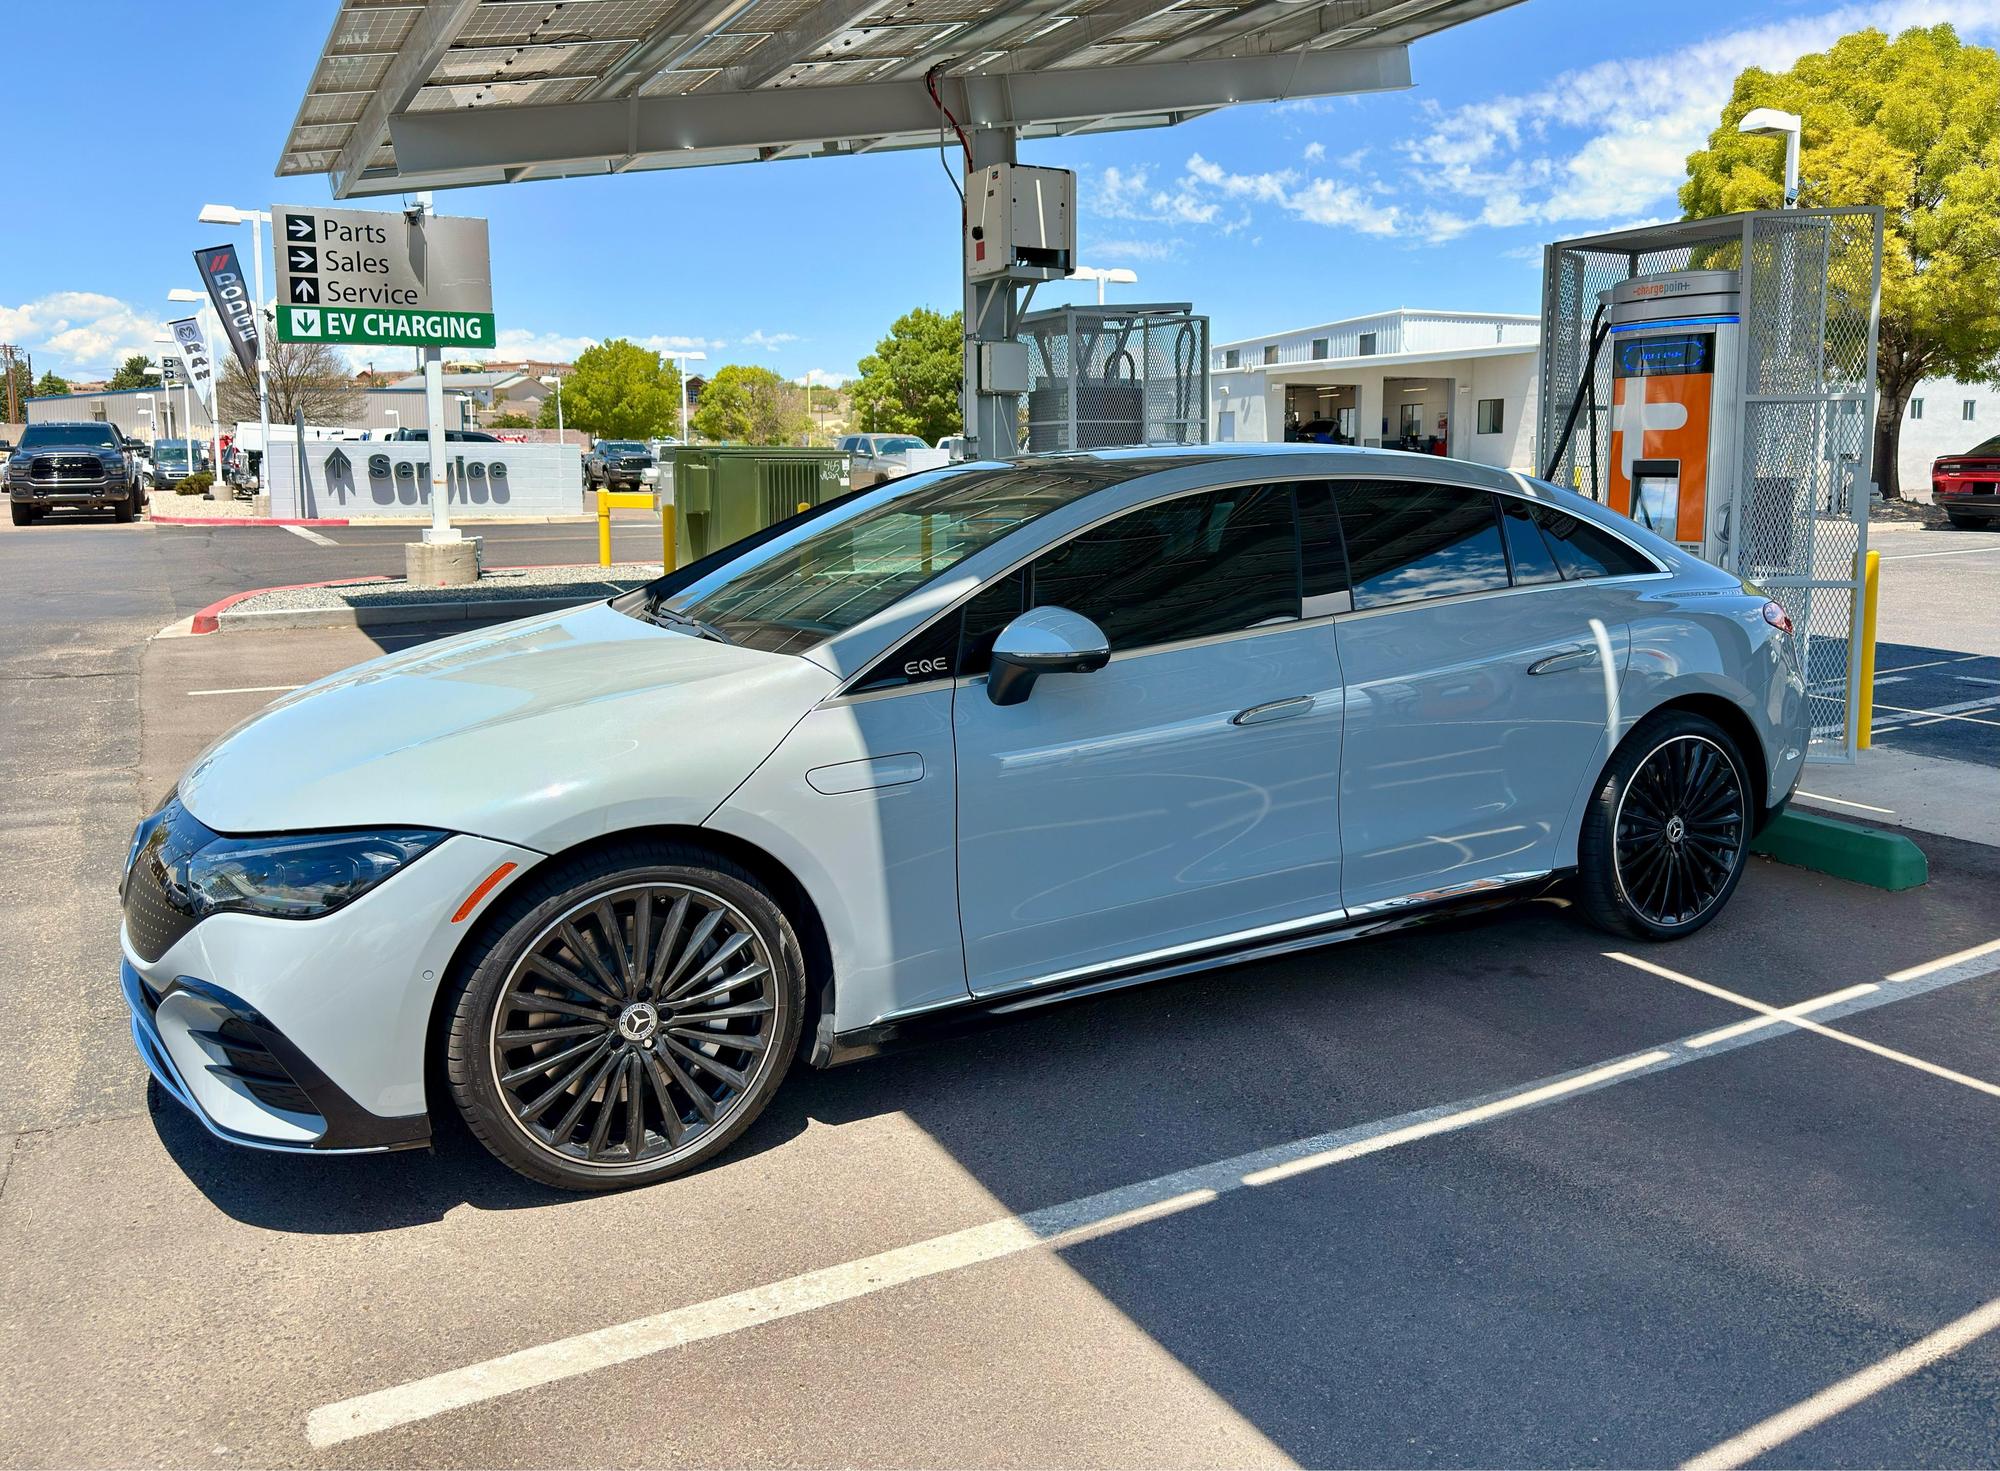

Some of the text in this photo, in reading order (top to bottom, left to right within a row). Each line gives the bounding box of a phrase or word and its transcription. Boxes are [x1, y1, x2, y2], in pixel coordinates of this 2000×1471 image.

[324, 219, 386, 243] Parts
[325, 250, 390, 274] Sales
[327, 280, 418, 305] Service
[214, 272, 257, 343] DODGE
[327, 312, 482, 339] EV CHARGING
[184, 342, 211, 381] RAM
[368, 453, 508, 480] Serice
[904, 656, 948, 675] EQE
